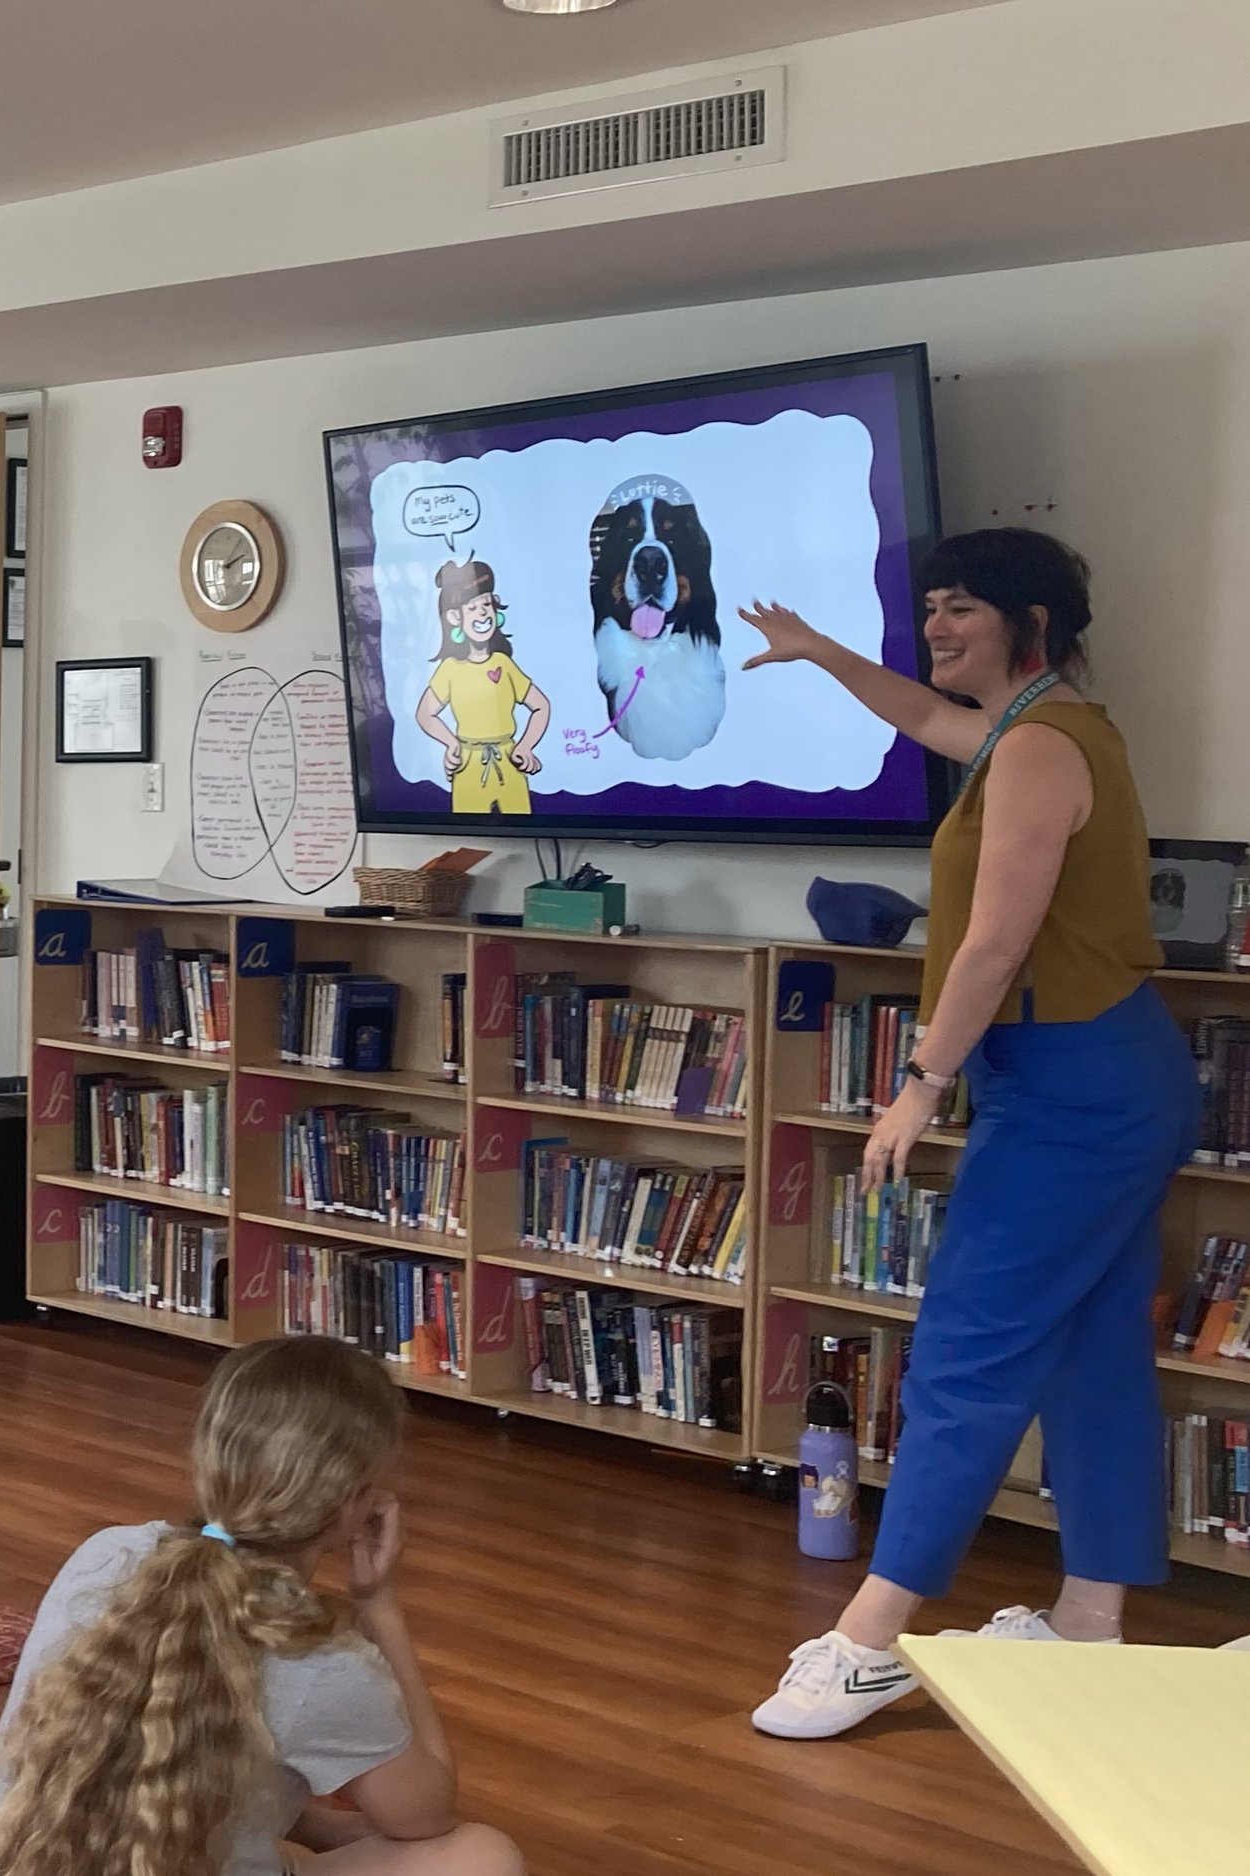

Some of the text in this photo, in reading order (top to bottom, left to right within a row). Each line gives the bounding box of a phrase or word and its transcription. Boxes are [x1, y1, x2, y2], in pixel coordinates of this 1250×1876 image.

[433, 494, 455, 508] pets
[619, 479, 668, 502] Lottie
[38, 932, 67, 957] a
[241, 942, 270, 968] a
[478, 975, 513, 1031] b
[39, 1070, 70, 1119] b
[778, 1161, 807, 1221] g
[241, 1244, 273, 1300] d
[478, 1284, 511, 1343] d
